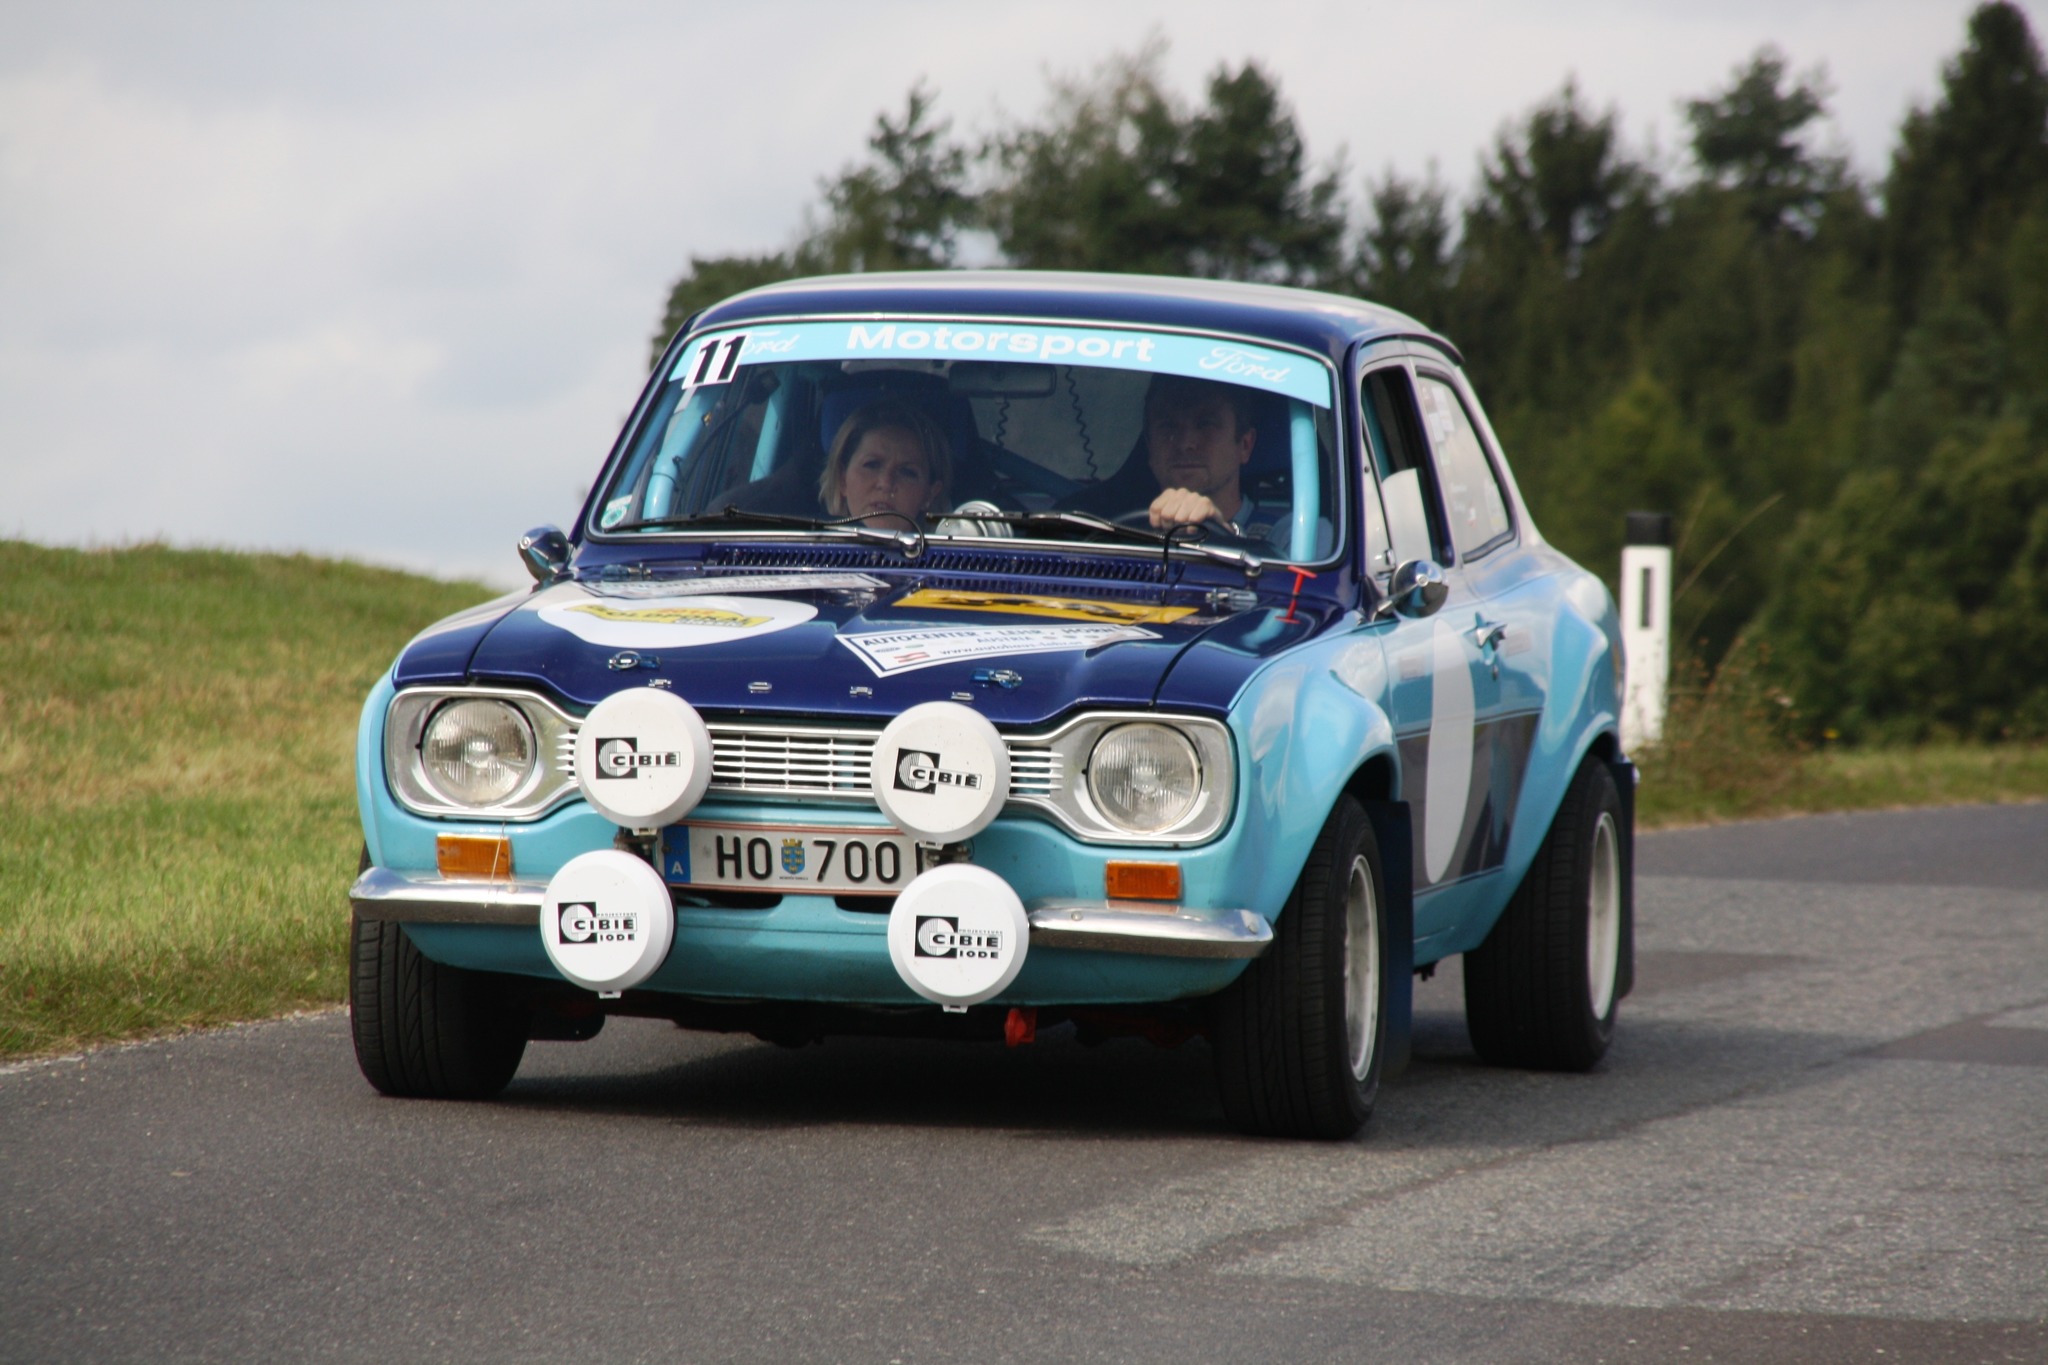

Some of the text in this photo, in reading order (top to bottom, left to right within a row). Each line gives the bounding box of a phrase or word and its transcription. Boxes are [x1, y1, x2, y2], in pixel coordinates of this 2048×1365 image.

[742, 329, 801, 356] ord
[846, 325, 1156, 362] Motorsport
[692, 334, 748, 385] 11
[1198, 346, 1292, 383] Ford
[862, 630, 978, 647] AUTOCENTER
[671, 860, 684, 875] A
[716, 834, 773, 880] HO
[600, 933, 635, 942] IODE
[960, 950, 999, 959] IODE
